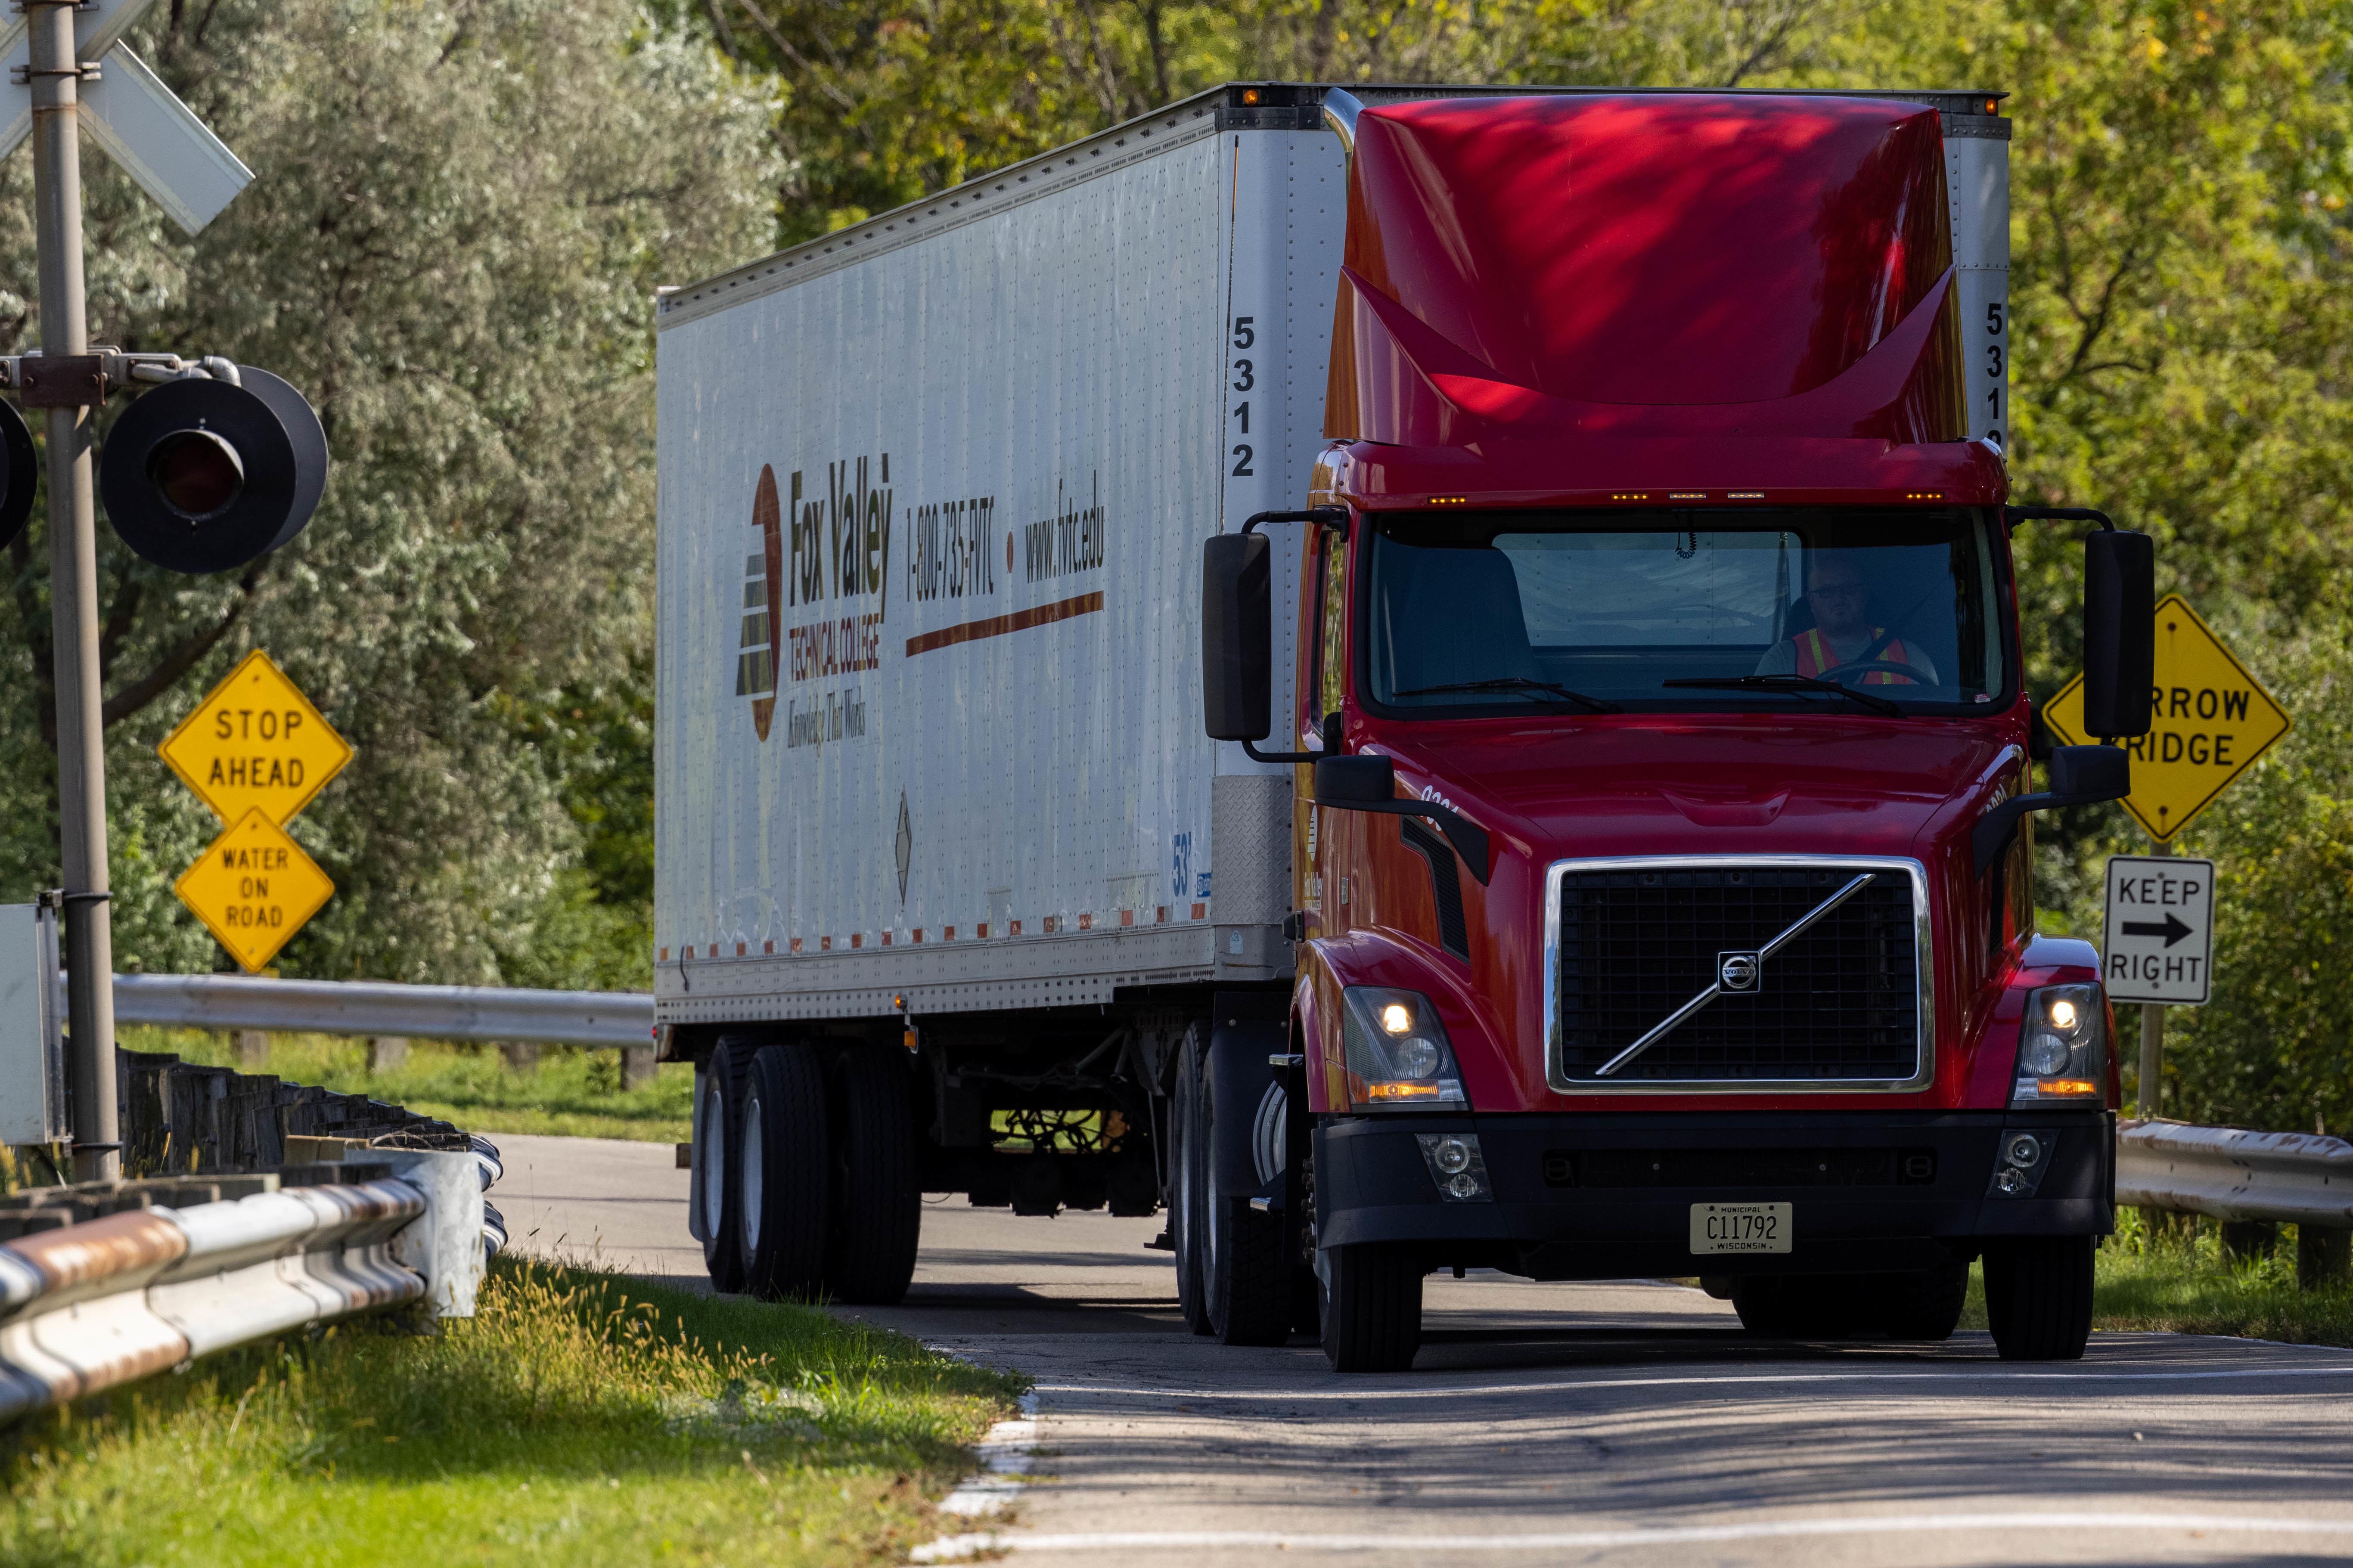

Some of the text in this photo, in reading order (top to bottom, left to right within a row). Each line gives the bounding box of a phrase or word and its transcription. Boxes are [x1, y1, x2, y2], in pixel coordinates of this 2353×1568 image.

[1232, 316, 1255, 477] 5312
[790, 453, 892, 624] Fox Valley
[906, 469, 1104, 602] 1-800-735-FVTC www.fvtc.edu
[789, 613, 879, 682] TECHNICAL COLLEGE
[2153, 687, 2249, 722] RROW
[215, 709, 303, 740] STOP
[788, 686, 866, 757] Knowledge That Works
[2111, 731, 2234, 766] RIDGE
[208, 757, 305, 787] AHEAD
[222, 848, 288, 869] WATER
[240, 877, 268, 899] ON
[2119, 878, 2200, 905] KEEP
[226, 905, 282, 927] ROAD
[2111, 954, 2202, 982] RIGHT
[1707, 1215, 1776, 1239] C11792
